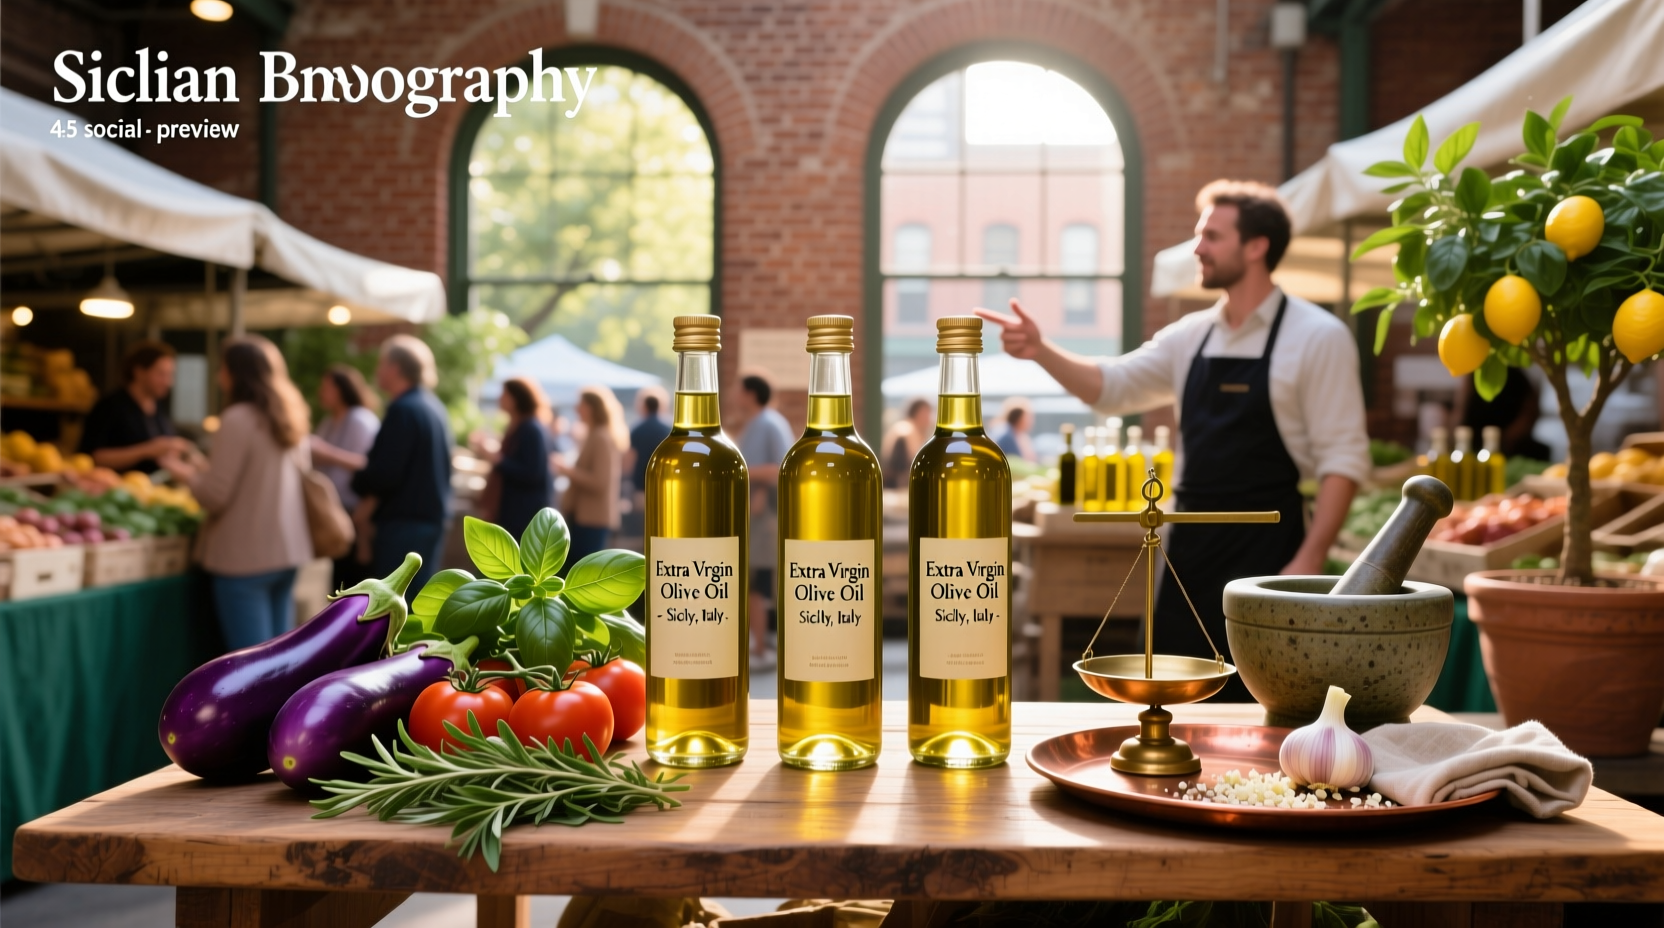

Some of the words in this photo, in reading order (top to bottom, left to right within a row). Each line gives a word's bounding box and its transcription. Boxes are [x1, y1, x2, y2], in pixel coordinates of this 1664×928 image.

[656, 560, 690, 577] Extra
[789, 562, 826, 579] Extra
[828, 562, 870, 583] Virgin
[926, 560, 963, 577] Extra
[661, 582, 700, 600] Olive
[705, 582, 728, 599] Oil
[795, 584, 836, 601] Olive
[840, 583, 864, 601] Oil
[930, 582, 972, 600] Olive
[976, 581, 999, 599] Oil
